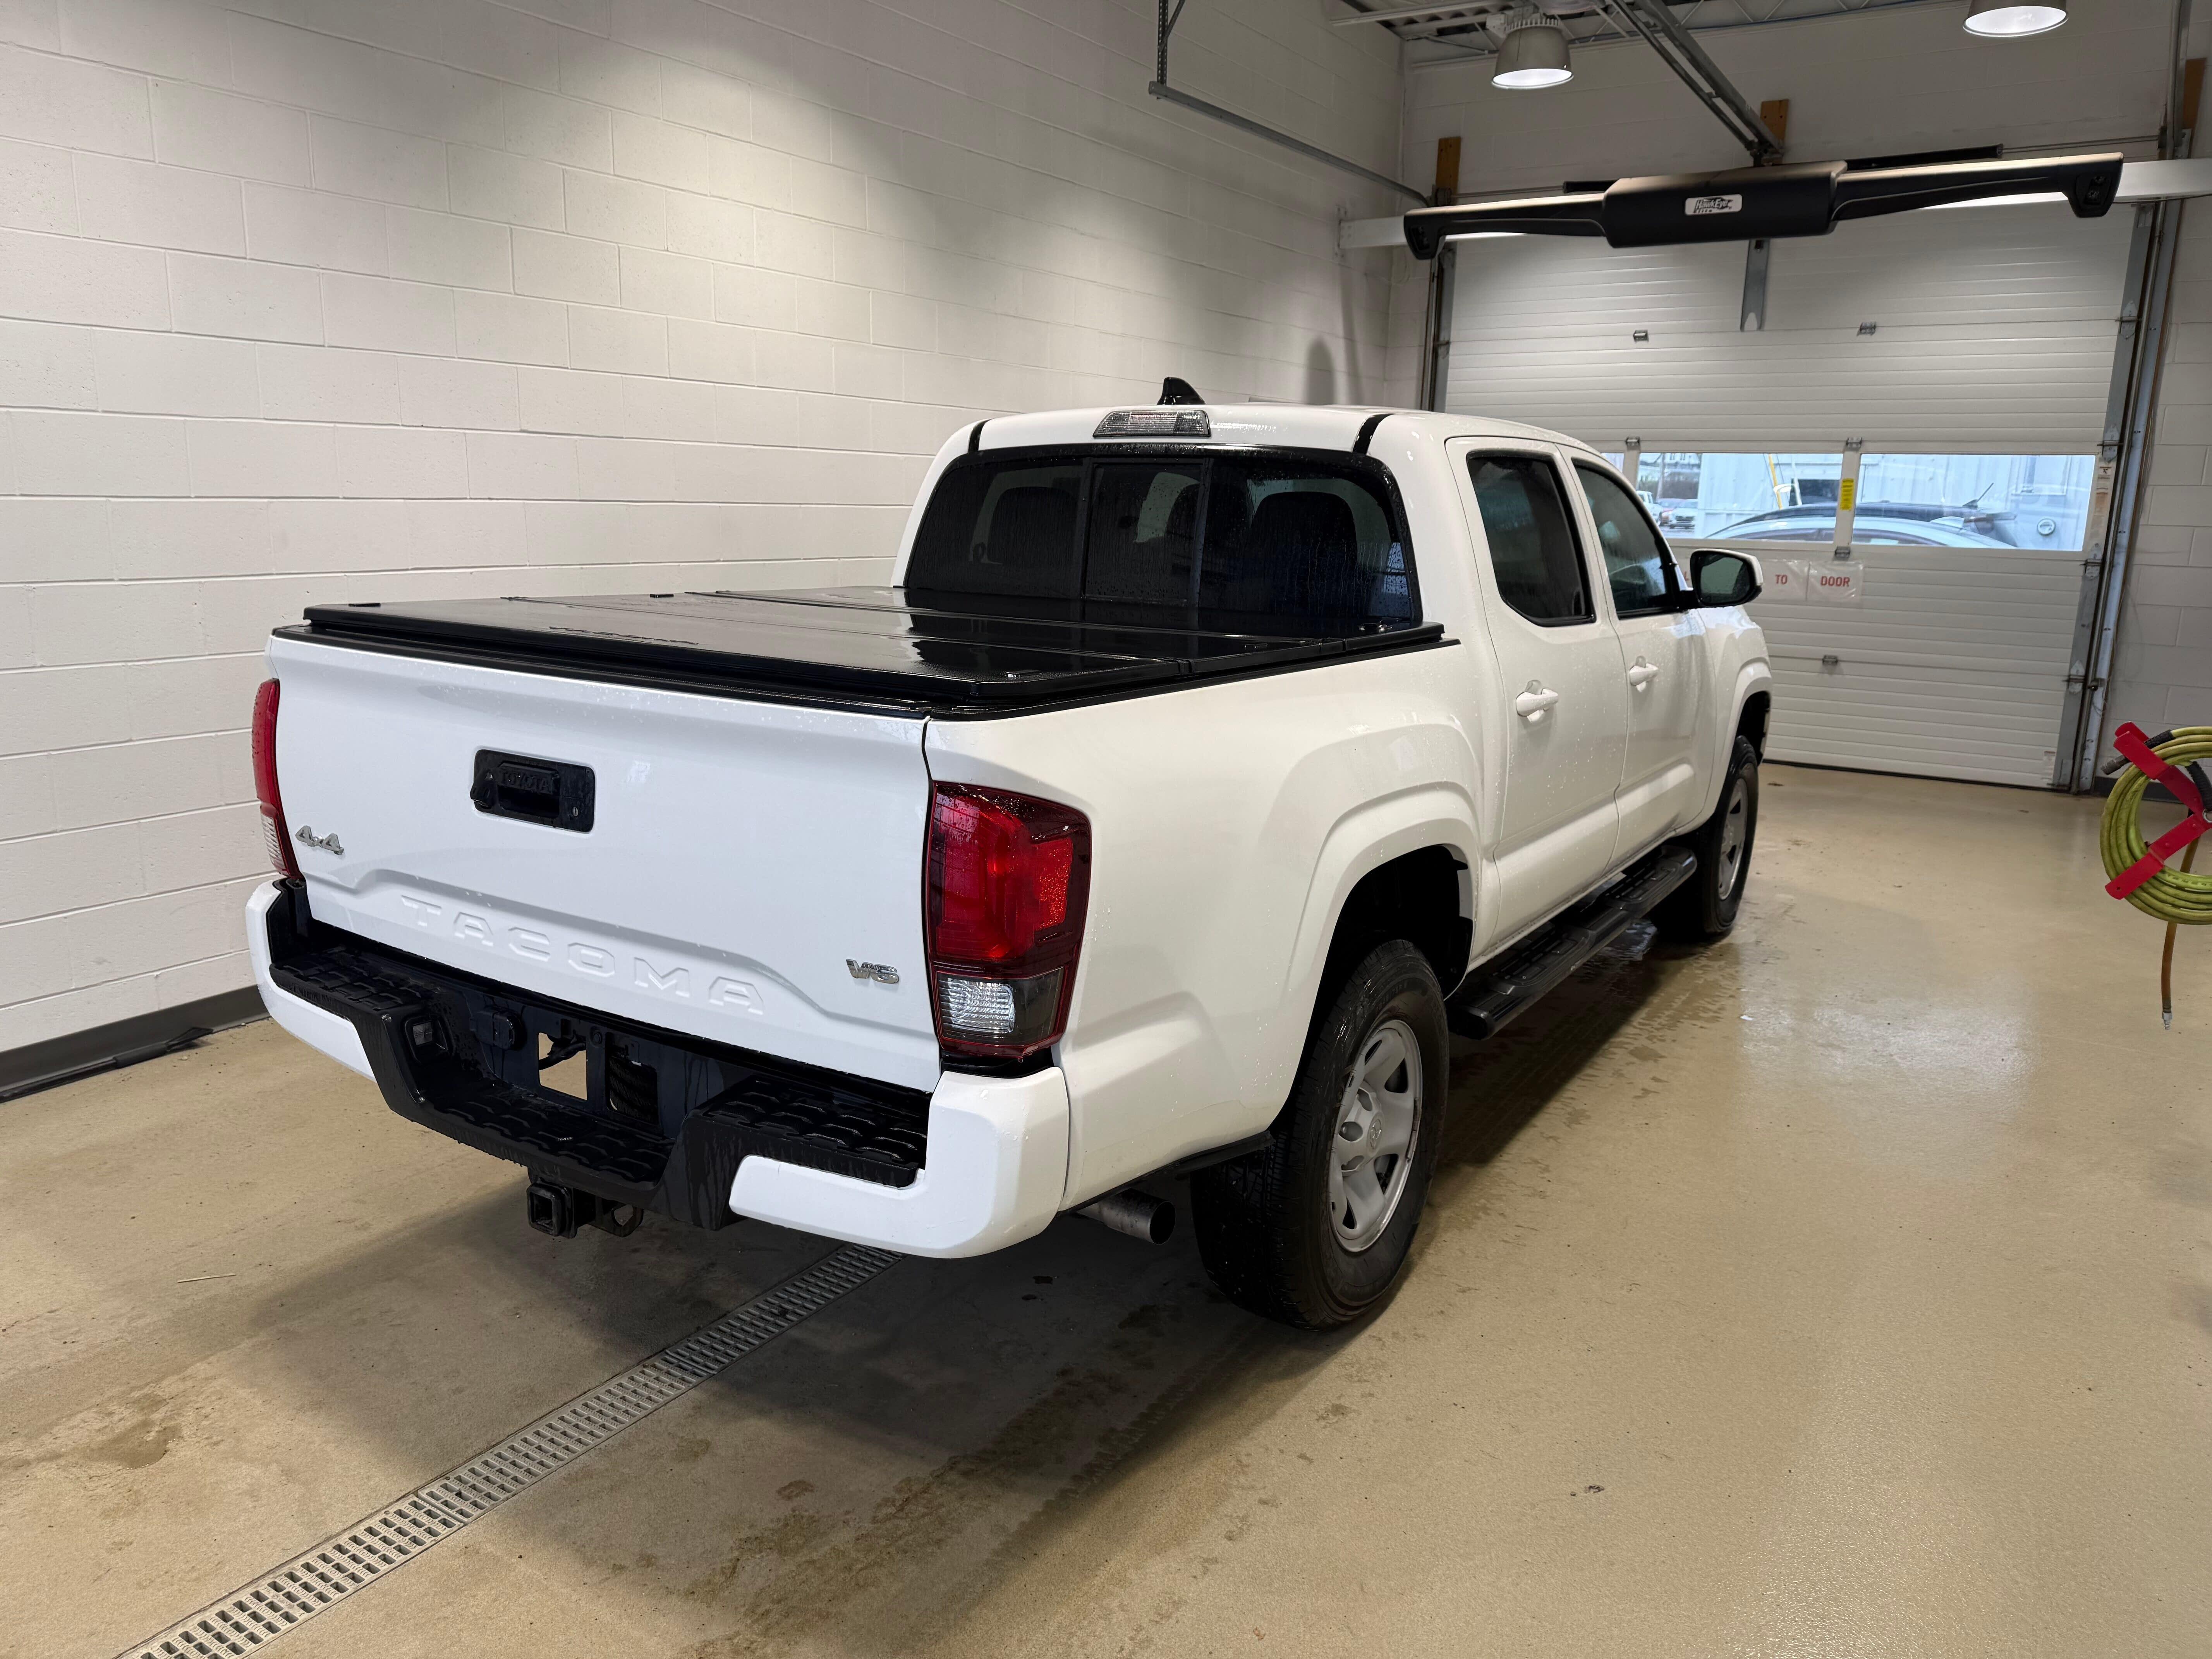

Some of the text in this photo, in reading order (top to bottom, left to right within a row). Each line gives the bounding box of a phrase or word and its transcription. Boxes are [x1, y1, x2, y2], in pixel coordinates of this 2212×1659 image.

[1776, 575, 1850, 587] TO DOOR
[502, 771, 550, 793] TOYOTA
[402, 895, 764, 1016] TACOMA
[846, 958, 900, 984] V6
